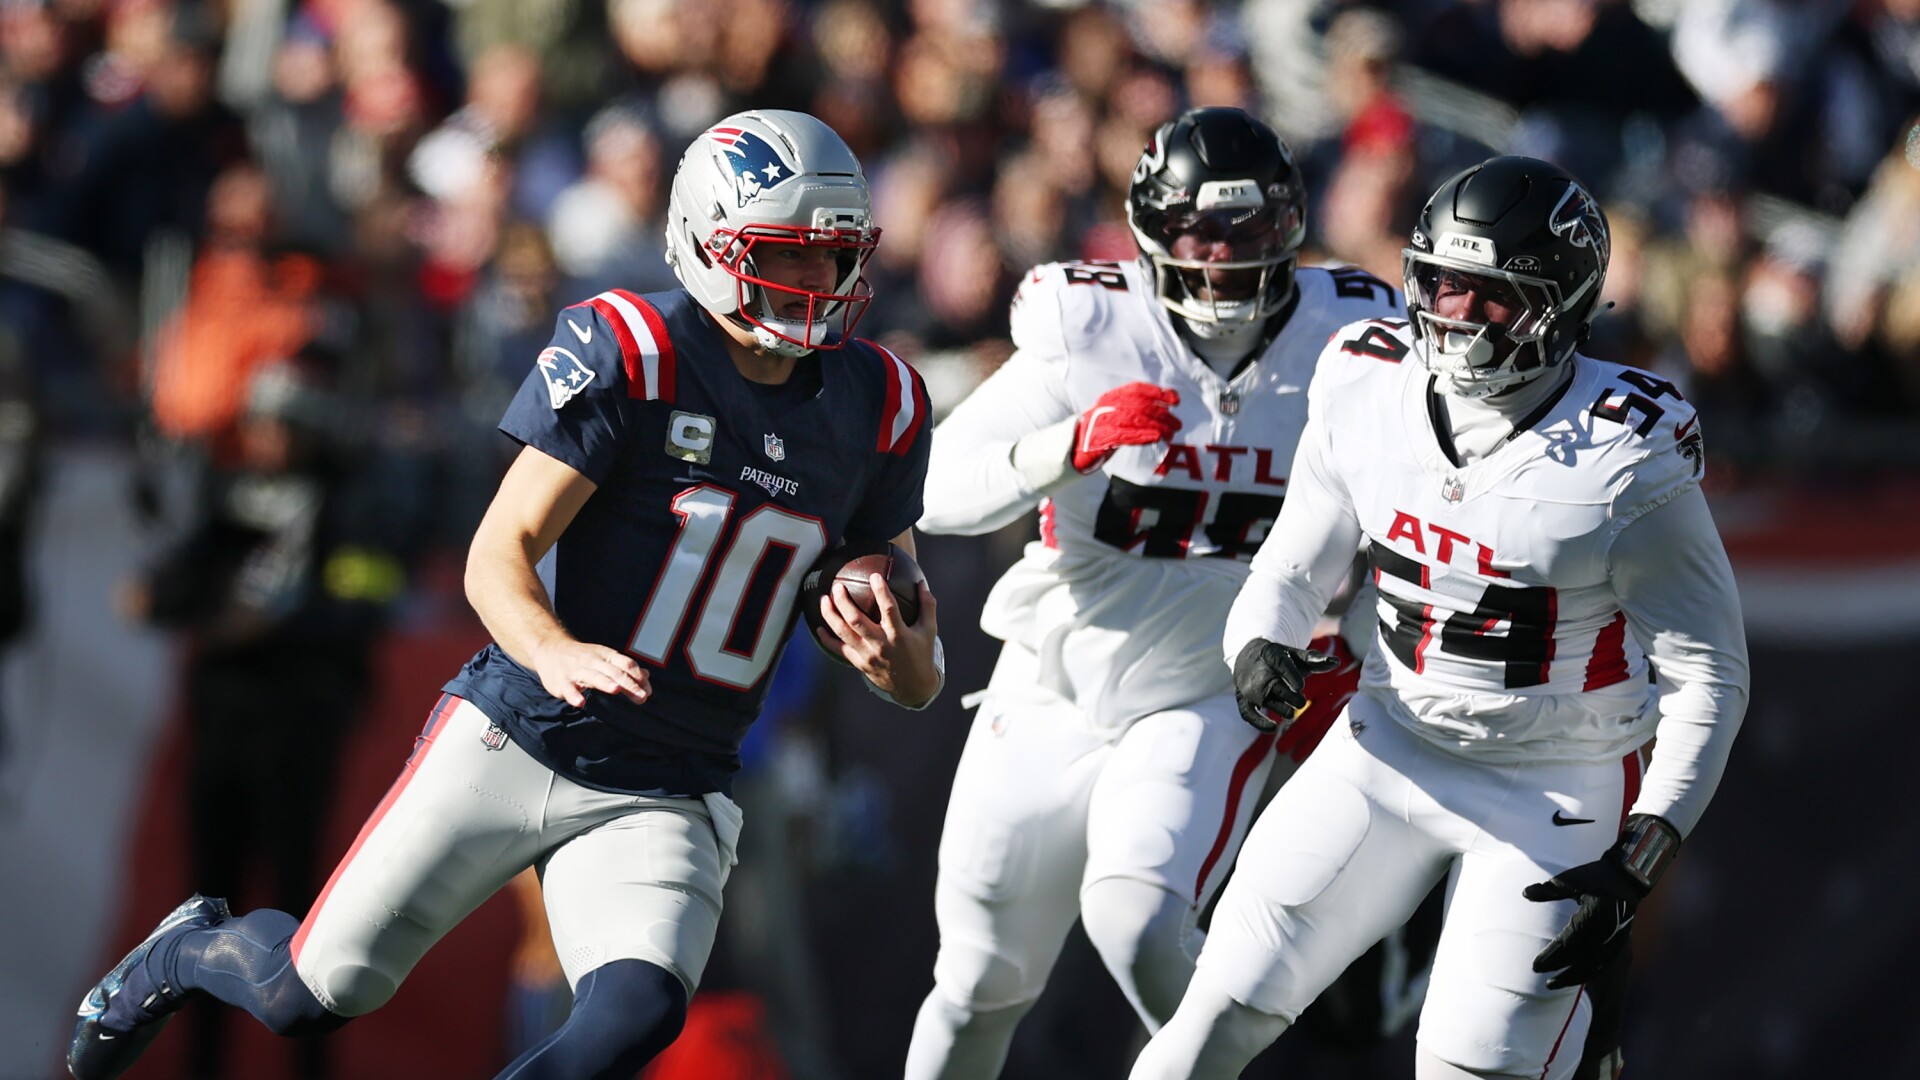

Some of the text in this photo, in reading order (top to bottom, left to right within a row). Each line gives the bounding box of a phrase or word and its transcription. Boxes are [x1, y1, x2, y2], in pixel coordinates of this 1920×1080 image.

[1450, 237, 1482, 253] ATL
[1588, 369, 1685, 438] 54
[670, 415, 710, 451] C
[740, 466, 799, 496] PATRIOTS
[1153, 443, 1286, 487] ATL
[1386, 508, 1511, 578] ATL
[624, 482, 830, 692] 10
[1367, 539, 1558, 690] 54
